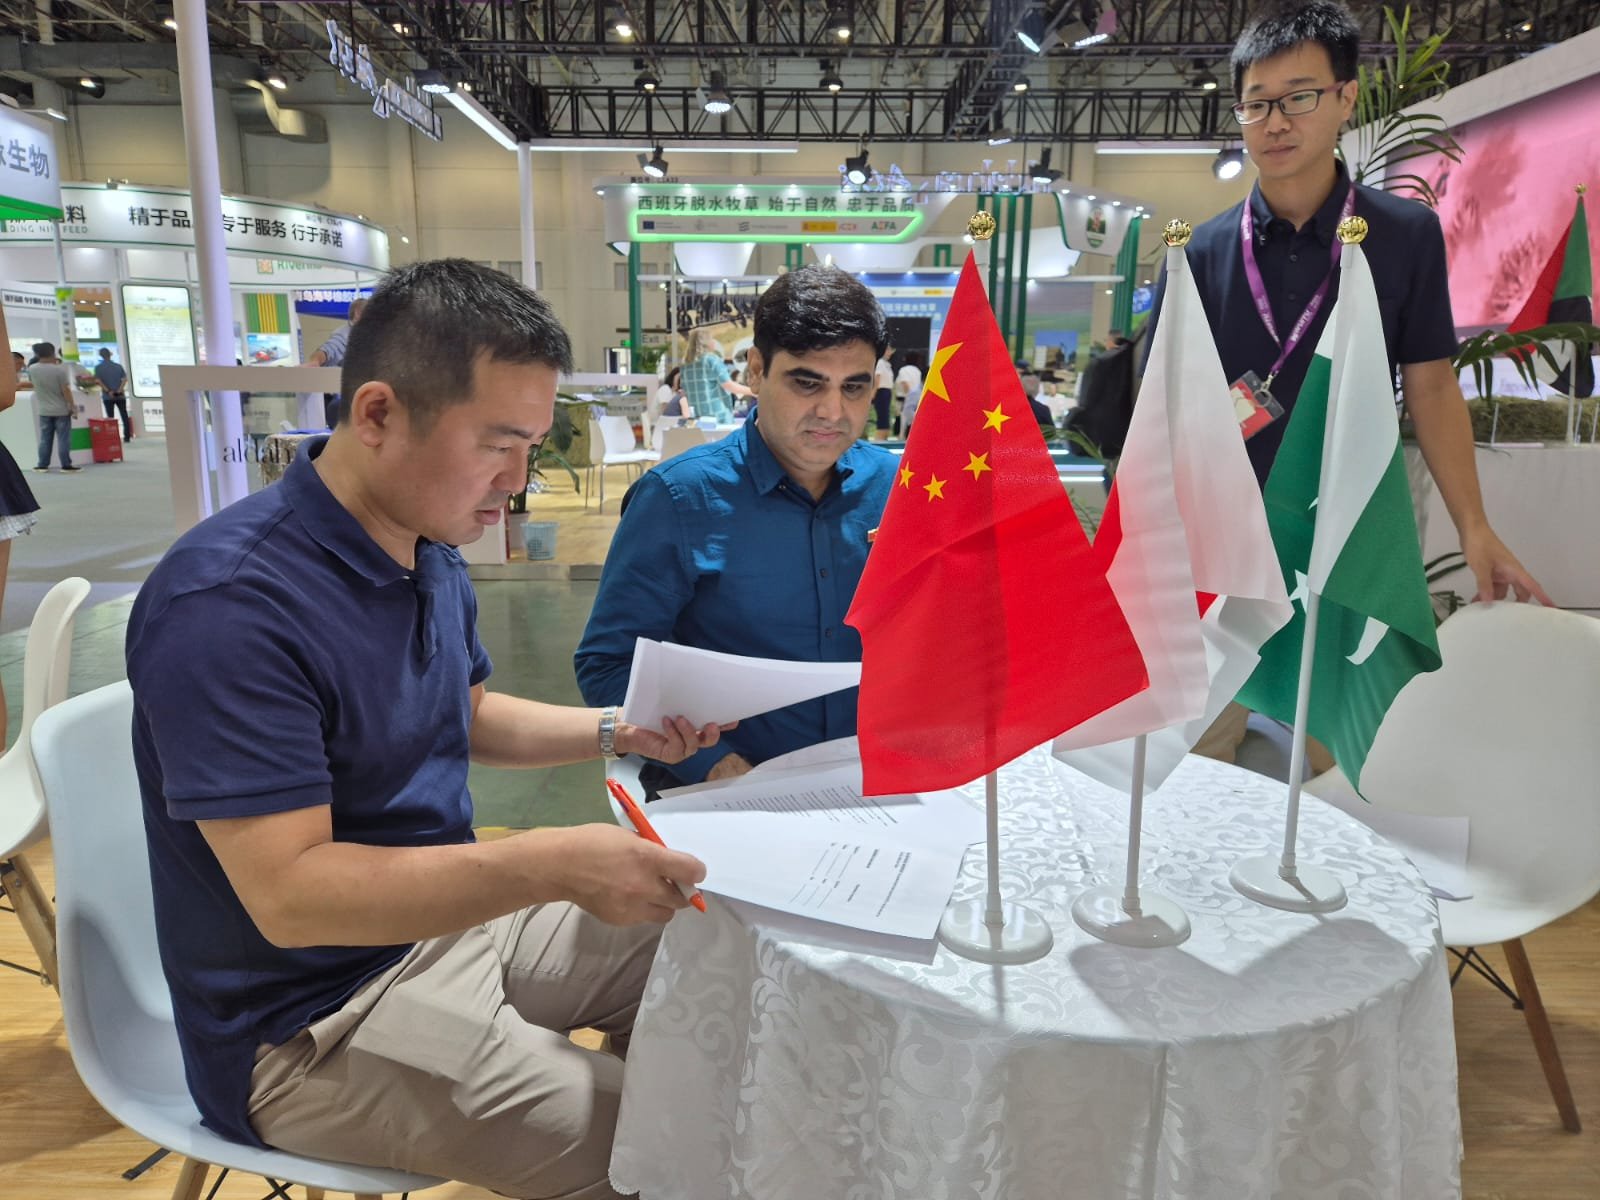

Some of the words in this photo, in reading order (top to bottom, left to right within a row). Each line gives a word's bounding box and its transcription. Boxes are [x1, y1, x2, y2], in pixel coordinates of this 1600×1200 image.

[638, 195, 759, 212] 西班牙脱水牧草
[768, 196, 837, 212] 始于自然
[847, 197, 915, 213] 忠于品质
[222, 214, 287, 238] 专于服务
[291, 223, 344, 249] 行于承诺
